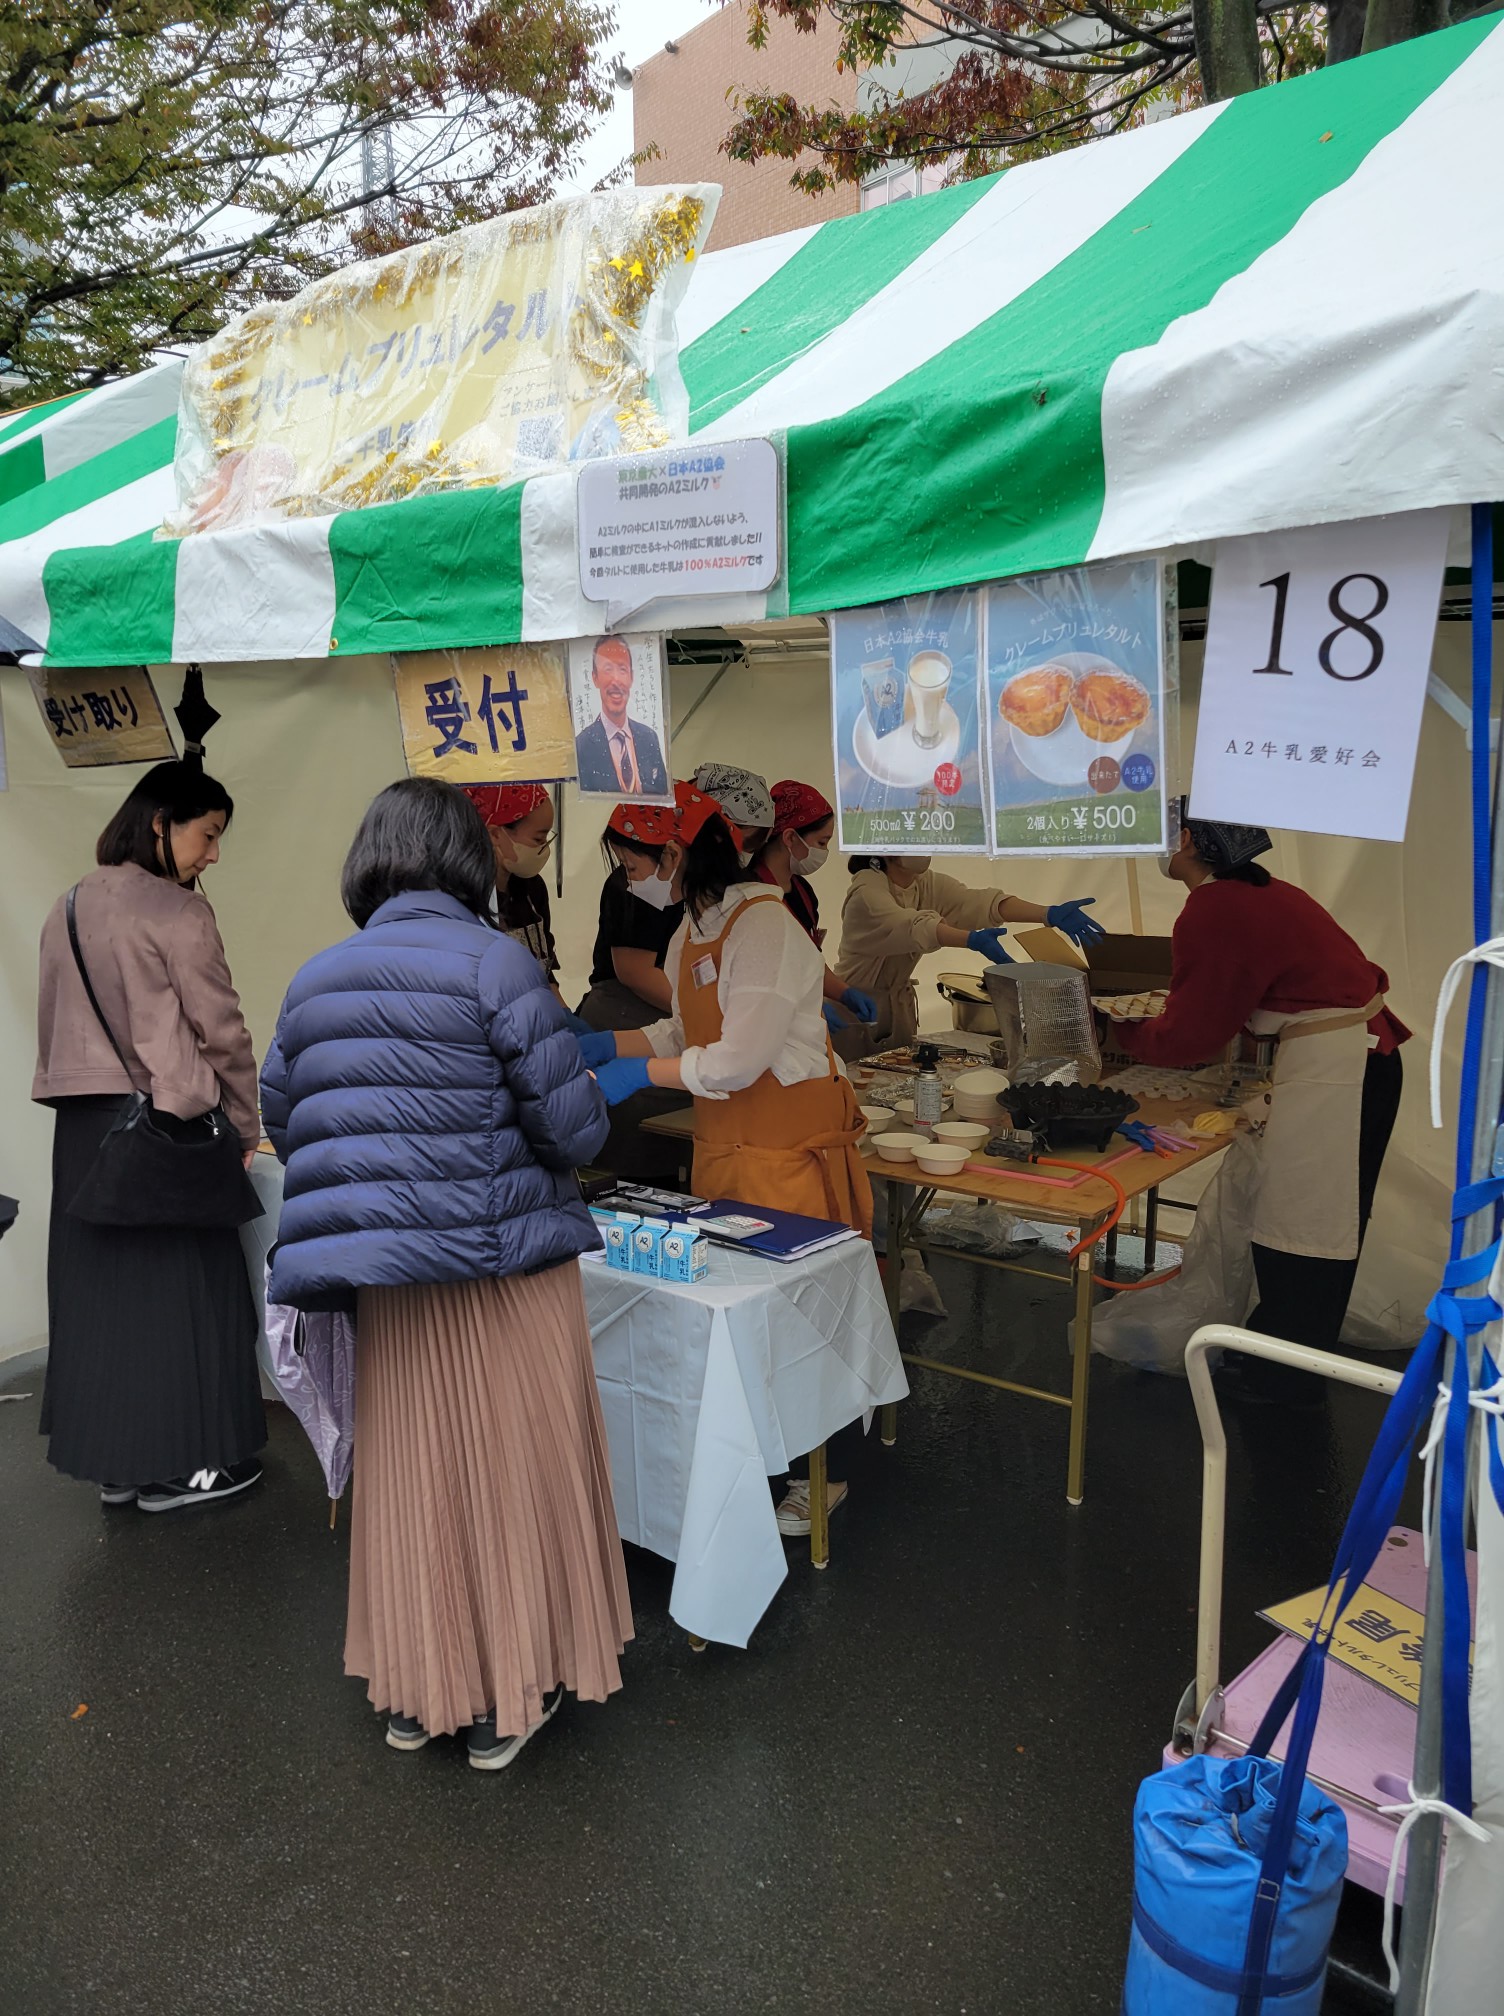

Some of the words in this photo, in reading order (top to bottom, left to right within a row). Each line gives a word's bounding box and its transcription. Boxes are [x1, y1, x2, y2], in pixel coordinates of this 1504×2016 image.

[618, 478, 709, 501] 共同開発のA2ミルク
[863, 628, 949, 653] 日本A2協会牛乳
[1252, 571, 1389, 681] 18
[1005, 621, 1142, 665] クレームブリュレタルト
[43, 686, 139, 737] 受け取り
[424, 670, 529, 758] 受付
[1225, 739, 1381, 768] A2牛乳愛好会
[1026, 816, 1071, 831] 2個入り
[1071, 804, 1136, 830] ¥500
[188, 1468, 220, 1490] N
